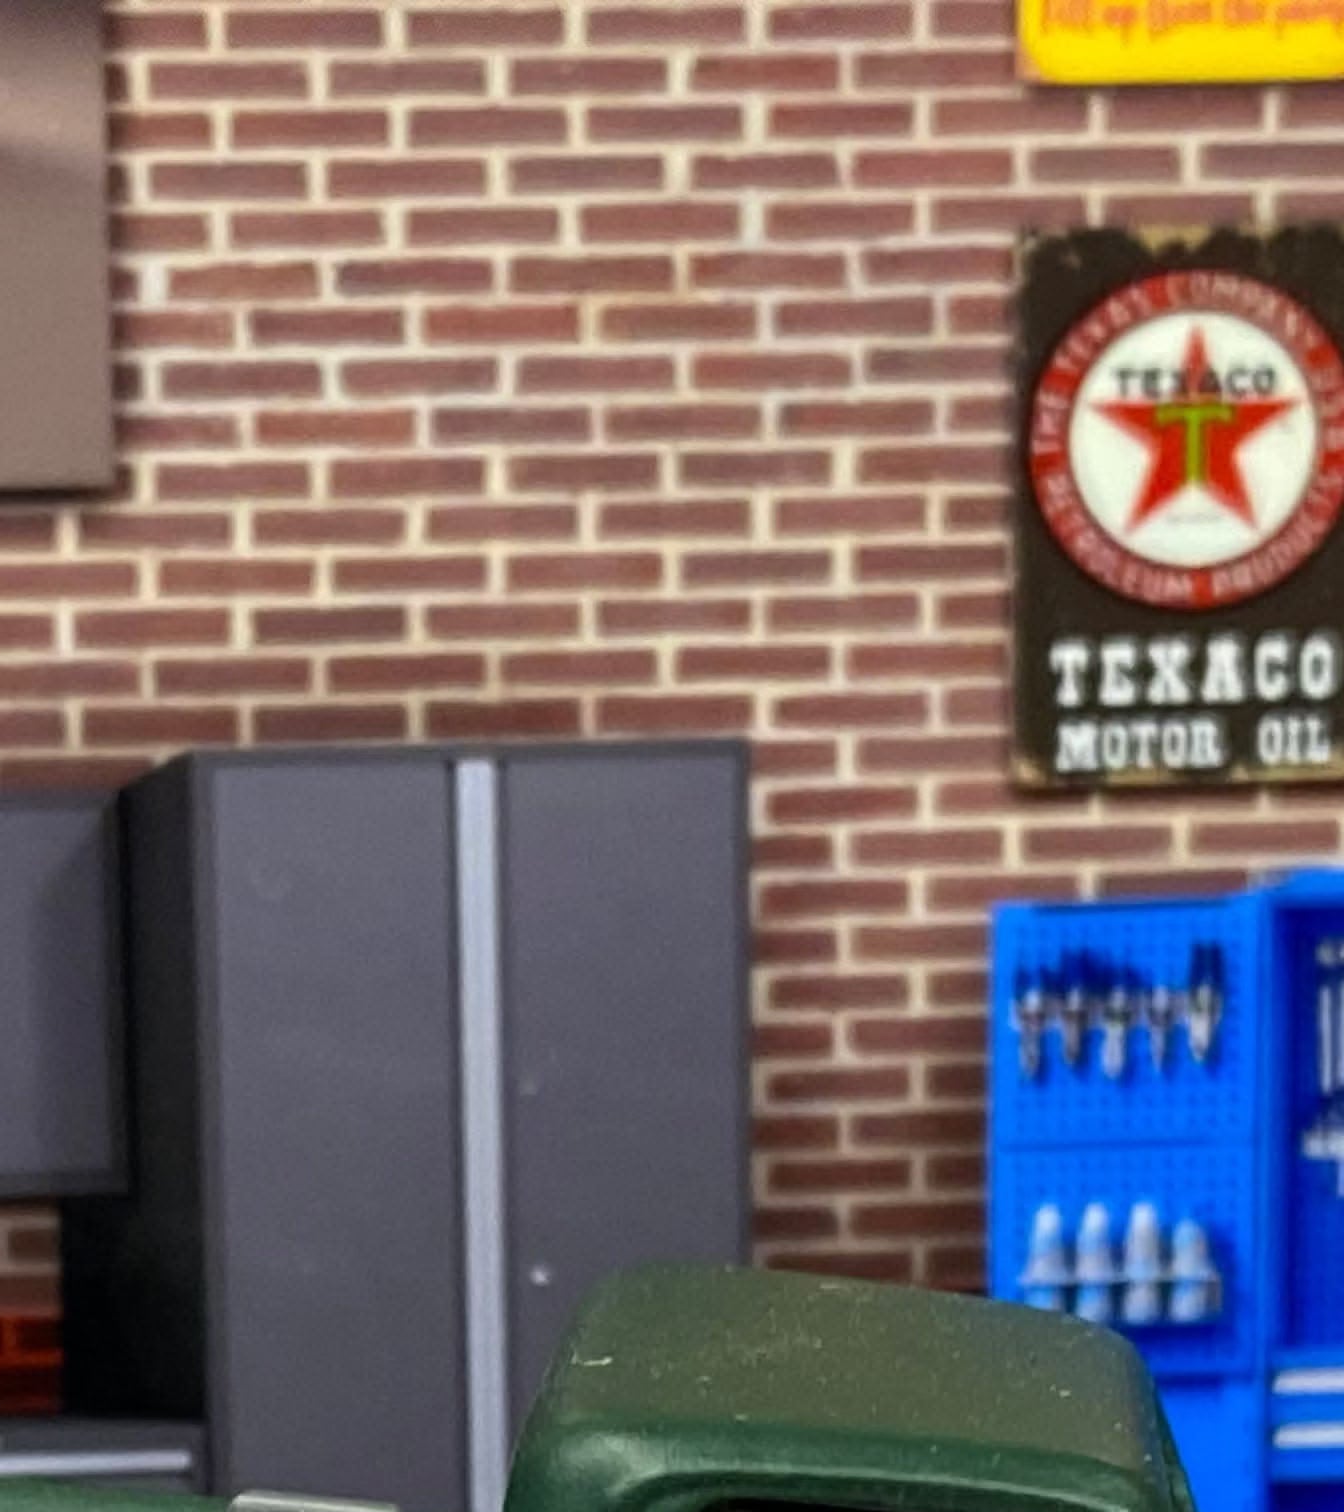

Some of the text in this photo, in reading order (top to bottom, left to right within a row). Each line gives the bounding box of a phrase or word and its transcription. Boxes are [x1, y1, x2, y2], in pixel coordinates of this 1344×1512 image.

[1115, 365, 1278, 398] TEXACO
[1049, 636, 1338, 706] TEXACO
[1056, 713, 1330, 772] MOTOR OIL
